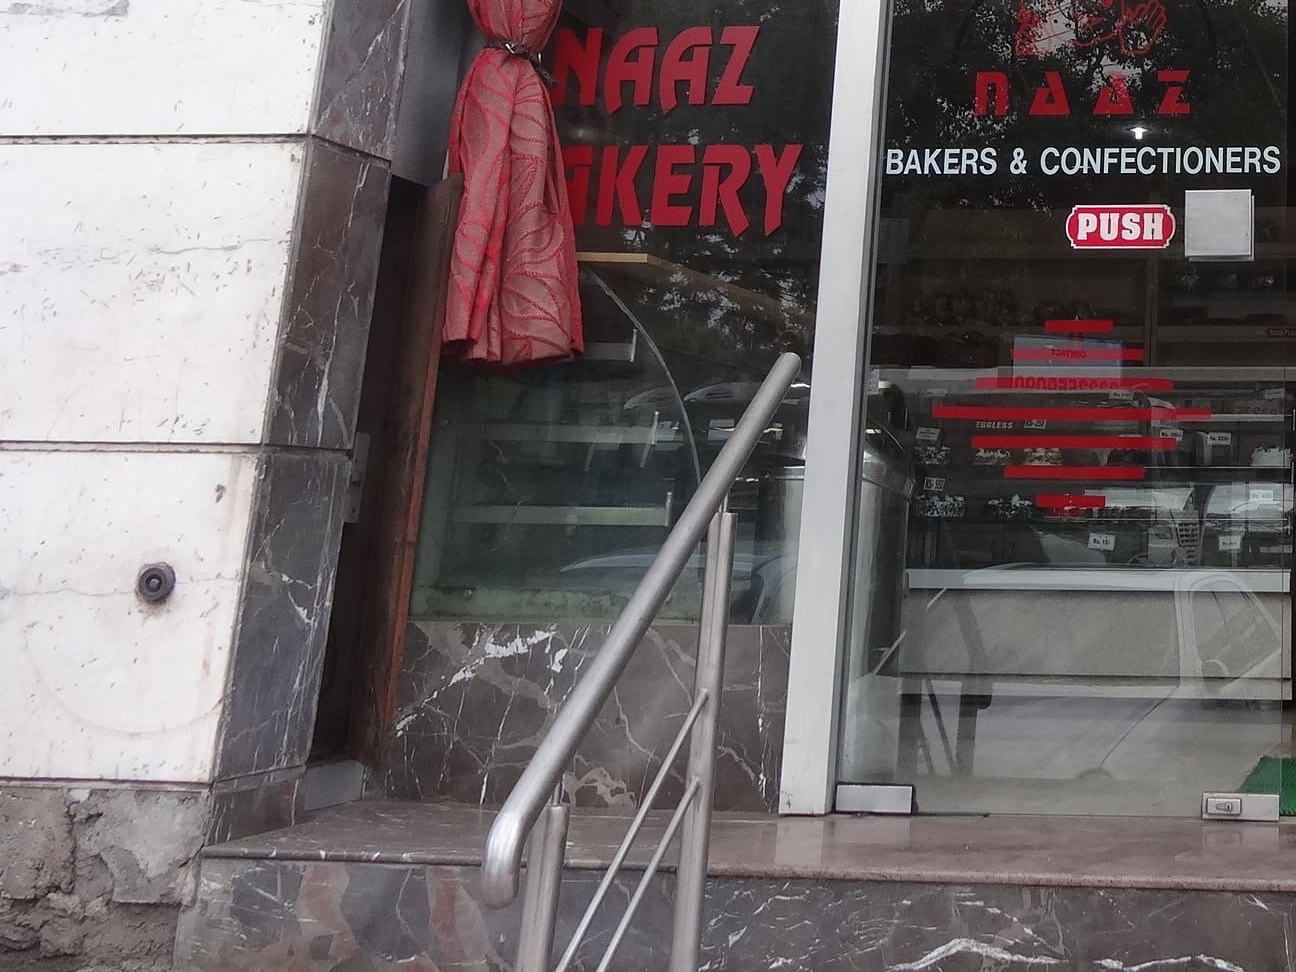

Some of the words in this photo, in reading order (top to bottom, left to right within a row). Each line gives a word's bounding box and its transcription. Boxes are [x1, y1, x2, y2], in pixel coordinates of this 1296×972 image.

[551, 25, 761, 115] NAAZ
[974, 70, 1191, 116] NAAZ
[886, 147, 998, 175] BAKERS
[1009, 147, 1027, 175] &
[1040, 146, 1281, 175] CONFECTIONERS
[1077, 212, 1164, 240] PUSH
[975, 421, 1014, 429] EGGLESS
